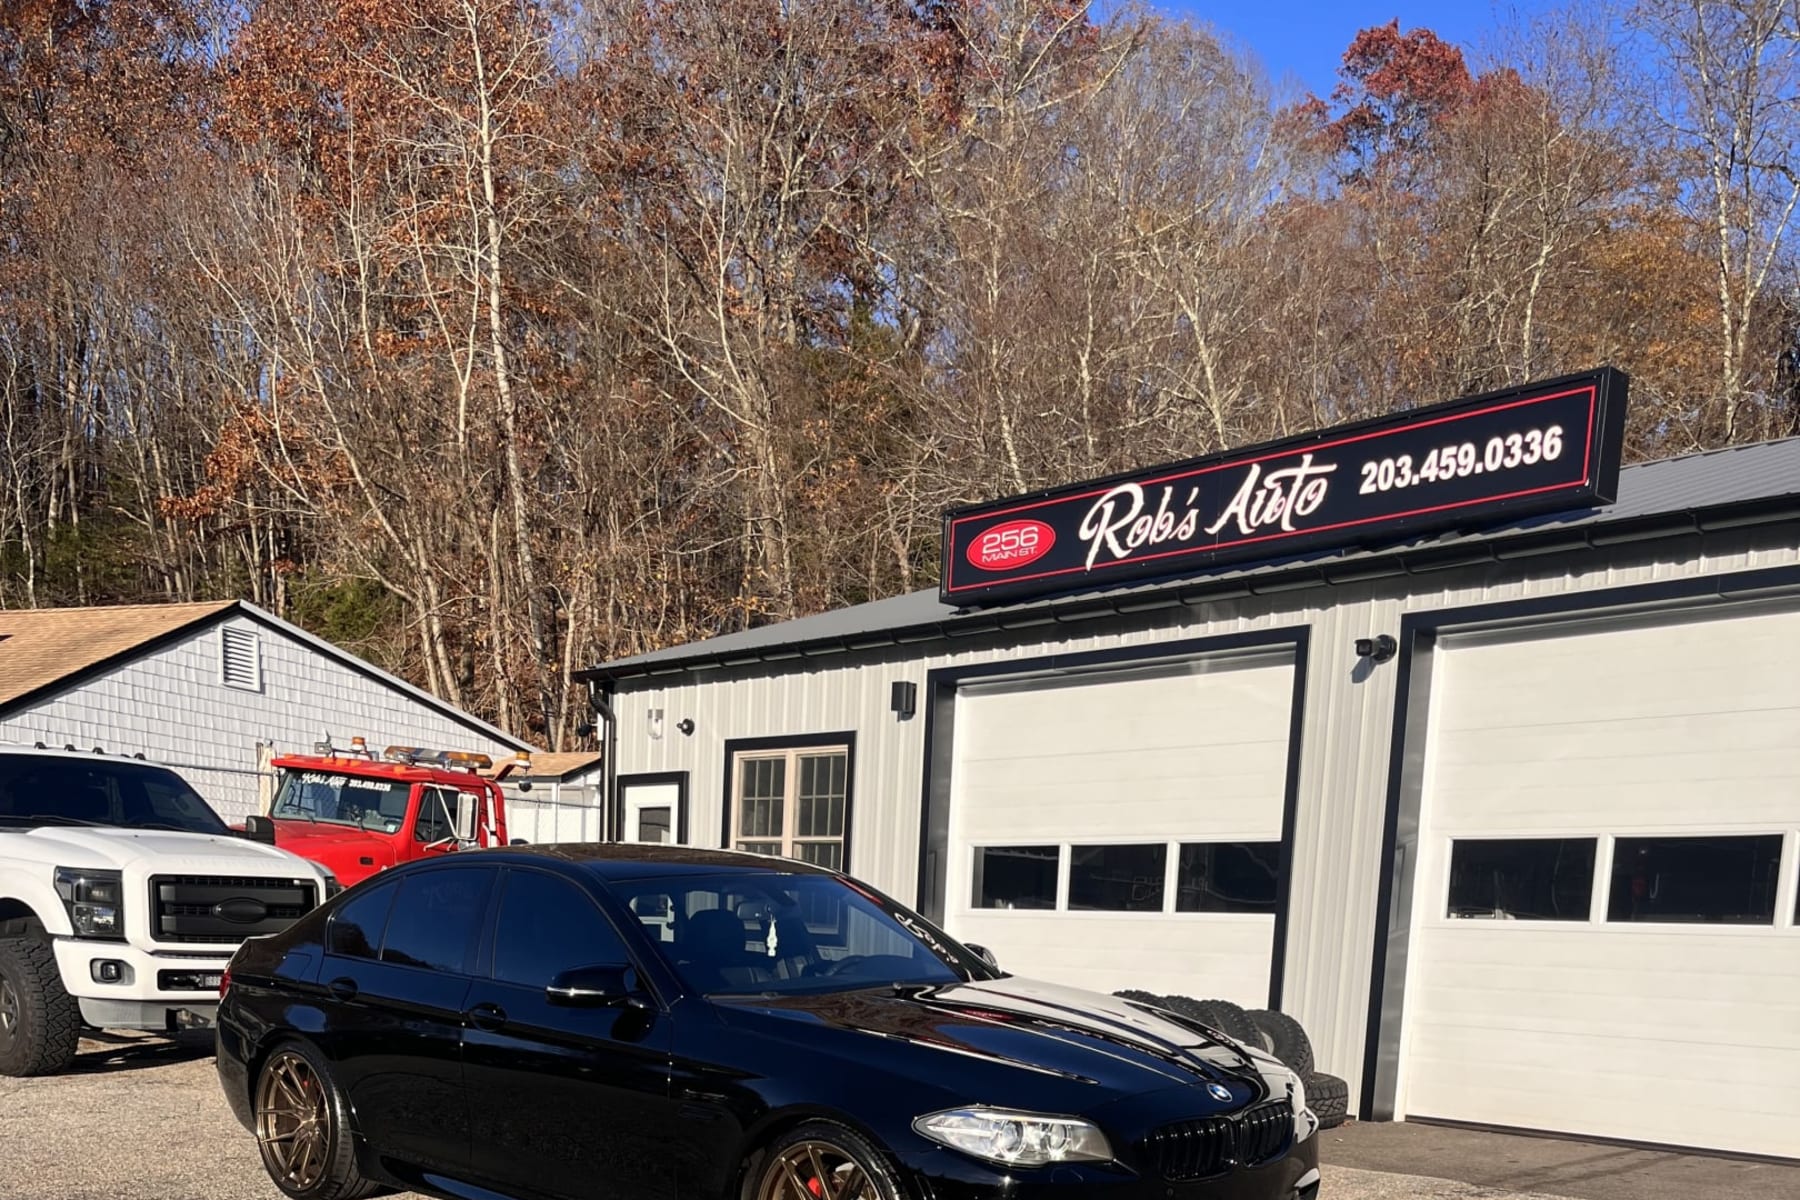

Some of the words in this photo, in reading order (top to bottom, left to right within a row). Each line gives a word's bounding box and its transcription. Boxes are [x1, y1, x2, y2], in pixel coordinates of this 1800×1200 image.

[1078, 483, 1199, 571] Rob's
[1204, 454, 1338, 534] Auto
[1359, 425, 1563, 494] 203.459.0336
[982, 526, 1039, 554] 256
[982, 550, 1018, 563] MAIN
